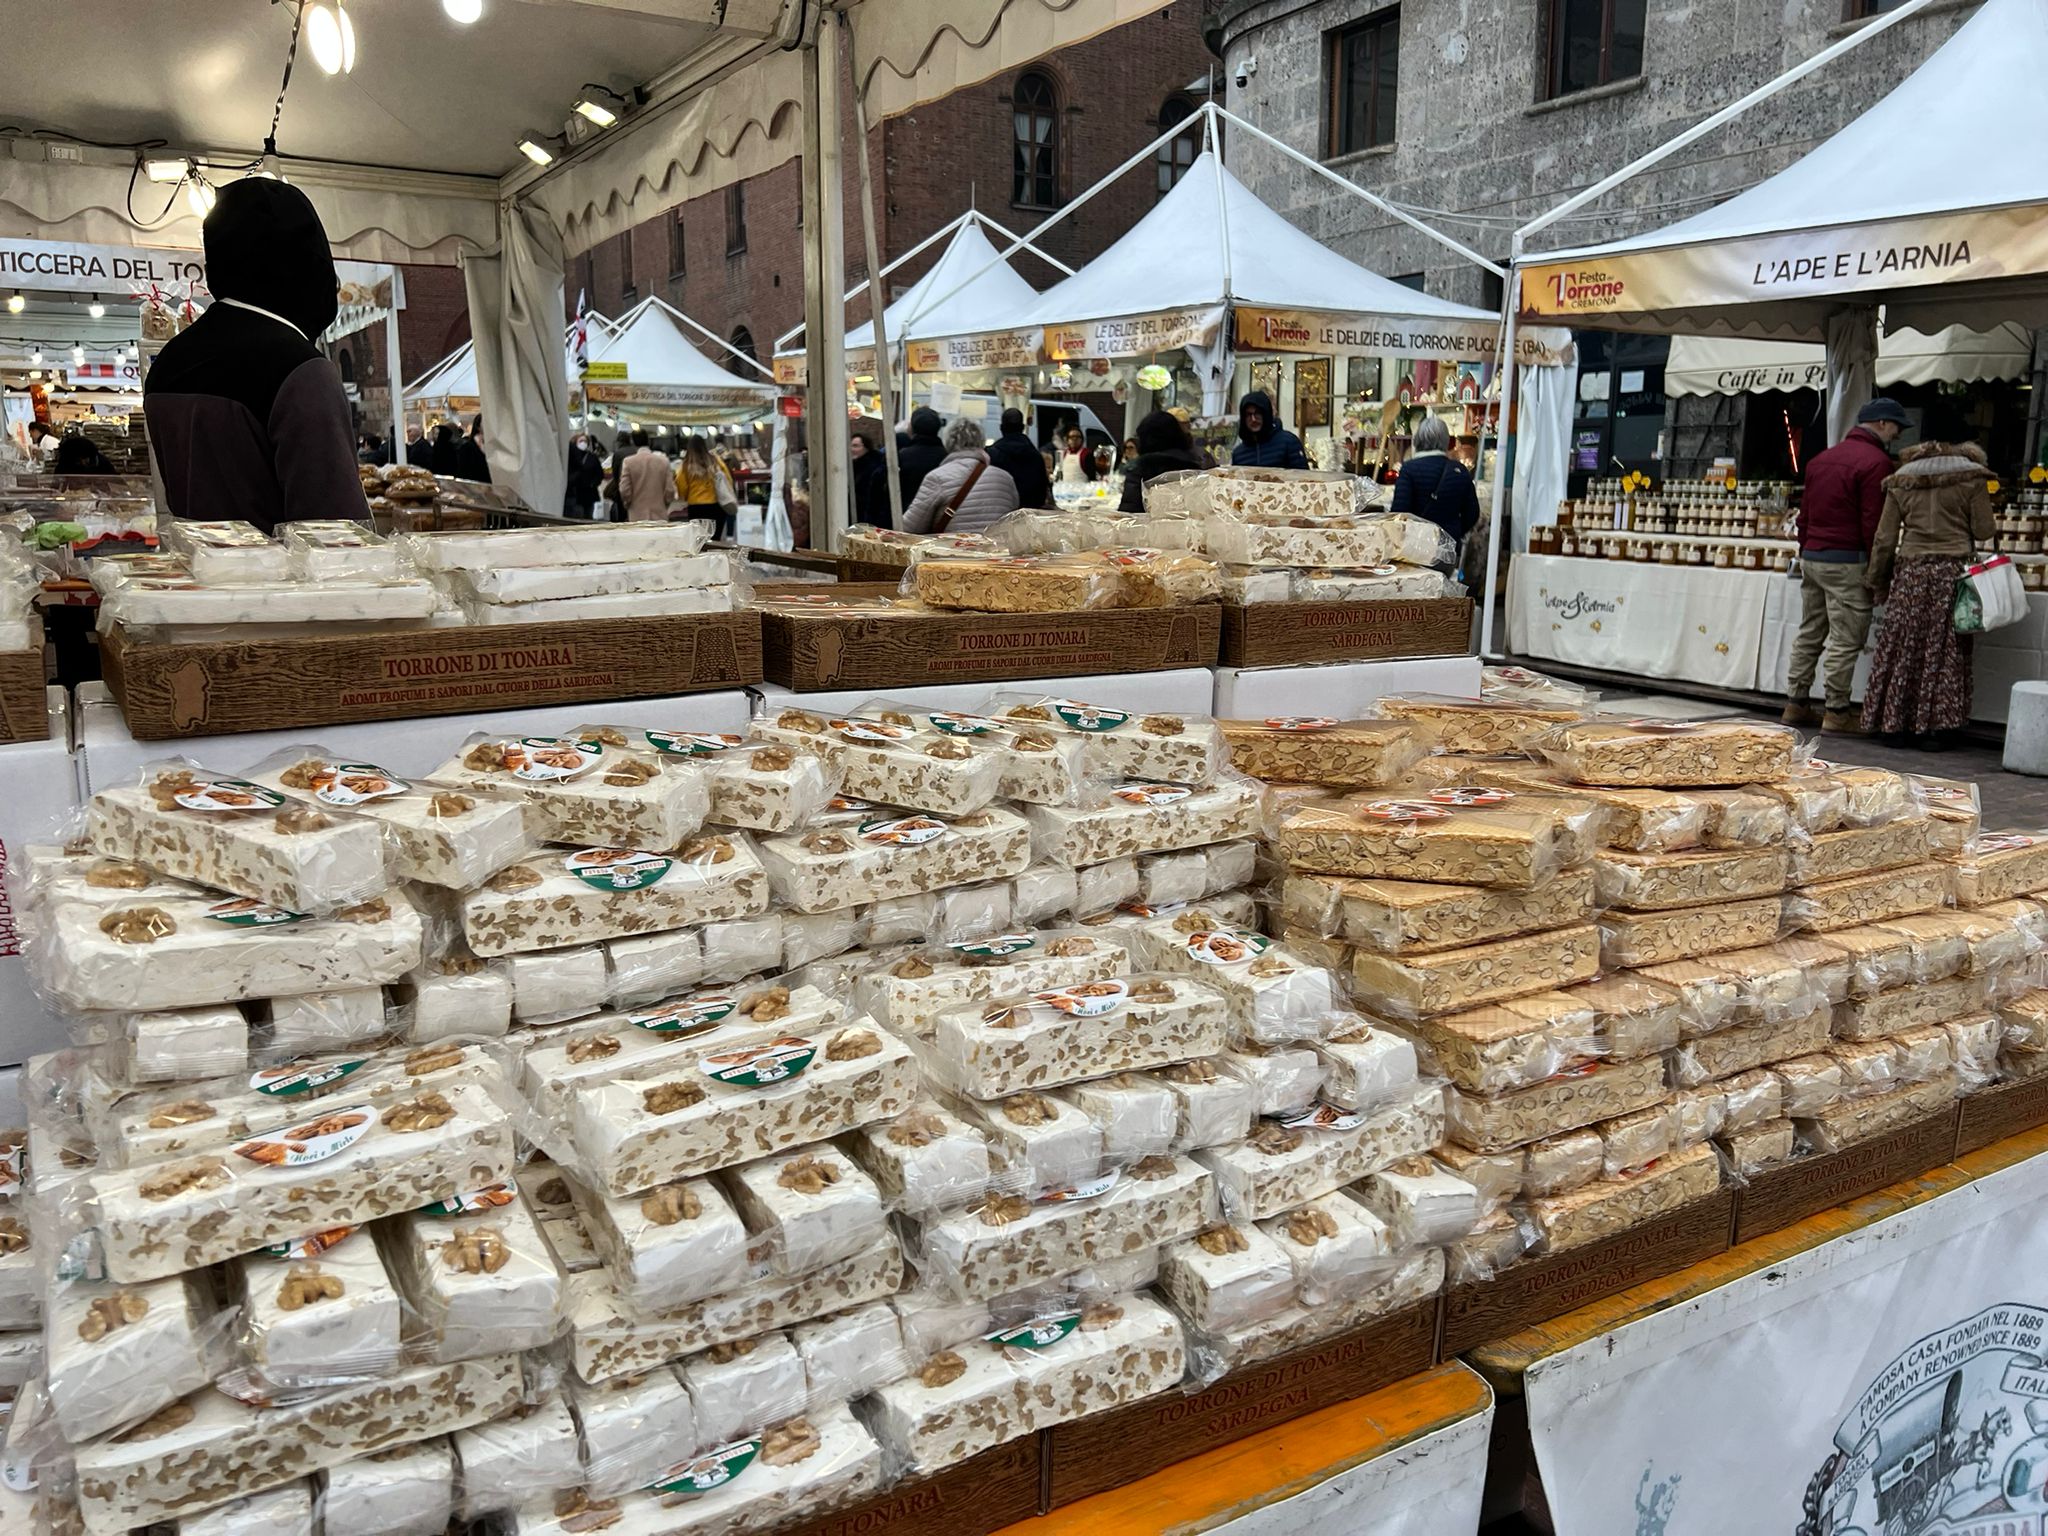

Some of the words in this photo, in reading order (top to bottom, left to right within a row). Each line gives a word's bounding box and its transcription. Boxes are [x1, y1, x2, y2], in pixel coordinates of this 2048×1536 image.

[113, 258, 163, 281] DEL
[168, 262, 207, 283] TO
[1579, 271, 1607, 284] Festa
[1753, 256, 1827, 285] L'APE
[1834, 253, 1851, 277] E
[1857, 240, 1972, 275] L'ARNIA
[1547, 272, 1624, 308] Torrone
[1571, 296, 1617, 309] CREMONA
[1095, 324, 1107, 339] LE
[1141, 320, 1158, 334] DEL
[1320, 328, 1334, 344] LE
[1337, 329, 1380, 347] DELIZIE
[1382, 333, 1406, 349] DEL
[1409, 334, 1465, 352] TORRONE
[1467, 337, 1519, 354] PUGLEE
[1523, 339, 1546, 356] (BA)
[1776, 368, 1795, 385] in
[1303, 609, 1361, 627] TORRONE
[1364, 610, 1378, 624] DI
[1380, 606, 1426, 623] TONARA
[961, 633, 1020, 650] TORRONE
[1022, 632, 1037, 647] DI
[1039, 630, 1086, 646] TONARA
[1331, 631, 1394, 648] SARDEGNA
[385, 654, 474, 679] TORRONE
[477, 653, 498, 671] DI
[501, 647, 573, 669] TONARA
[954, 659, 985, 669] PROFUMI
[993, 657, 1017, 667] SAPORI
[342, 693, 378, 706] AROMI
[380, 688, 427, 702] PROFUMI
[428, 688, 436, 699] E
[437, 685, 473, 699] SAPORI
[475, 683, 496, 695] DAL
[497, 680, 530, 693] CUORE
[532, 679, 562, 690] DELLA
[563, 674, 613, 687] SARDEGNA
[1802, 1153, 1860, 1185] TORRONE
[1862, 1148, 1876, 1165] DI
[1877, 1129, 1922, 1158] TONARA
[1825, 1165, 1887, 1198] SARDEGNA
[1522, 1254, 1598, 1296] TORRONE
[1600, 1248, 1620, 1269] DI
[1622, 1223, 1680, 1262] TONARA
[1557, 1265, 1638, 1306] SARDEGNA
[1859, 1363, 1905, 1417] FAMOSA
[1908, 1339, 1942, 1368] CASA
[1990, 1311, 2011, 1327] NEL
[2013, 1313, 2044, 1330] 1889
[1155, 1380, 1260, 1427] TORRONE
[1263, 1371, 1284, 1390] DI
[1291, 1339, 1367, 1380] TONARA
[1859, 1422, 1867, 1436] A
[1868, 1367, 1920, 1418] COMPANY
[1924, 1340, 1982, 1380] RENOWNED
[2011, 1332, 2042, 1349] 1889
[2015, 1376, 2048, 1394] ITAL
[1204, 1386, 1311, 1438] SARDEGNA
